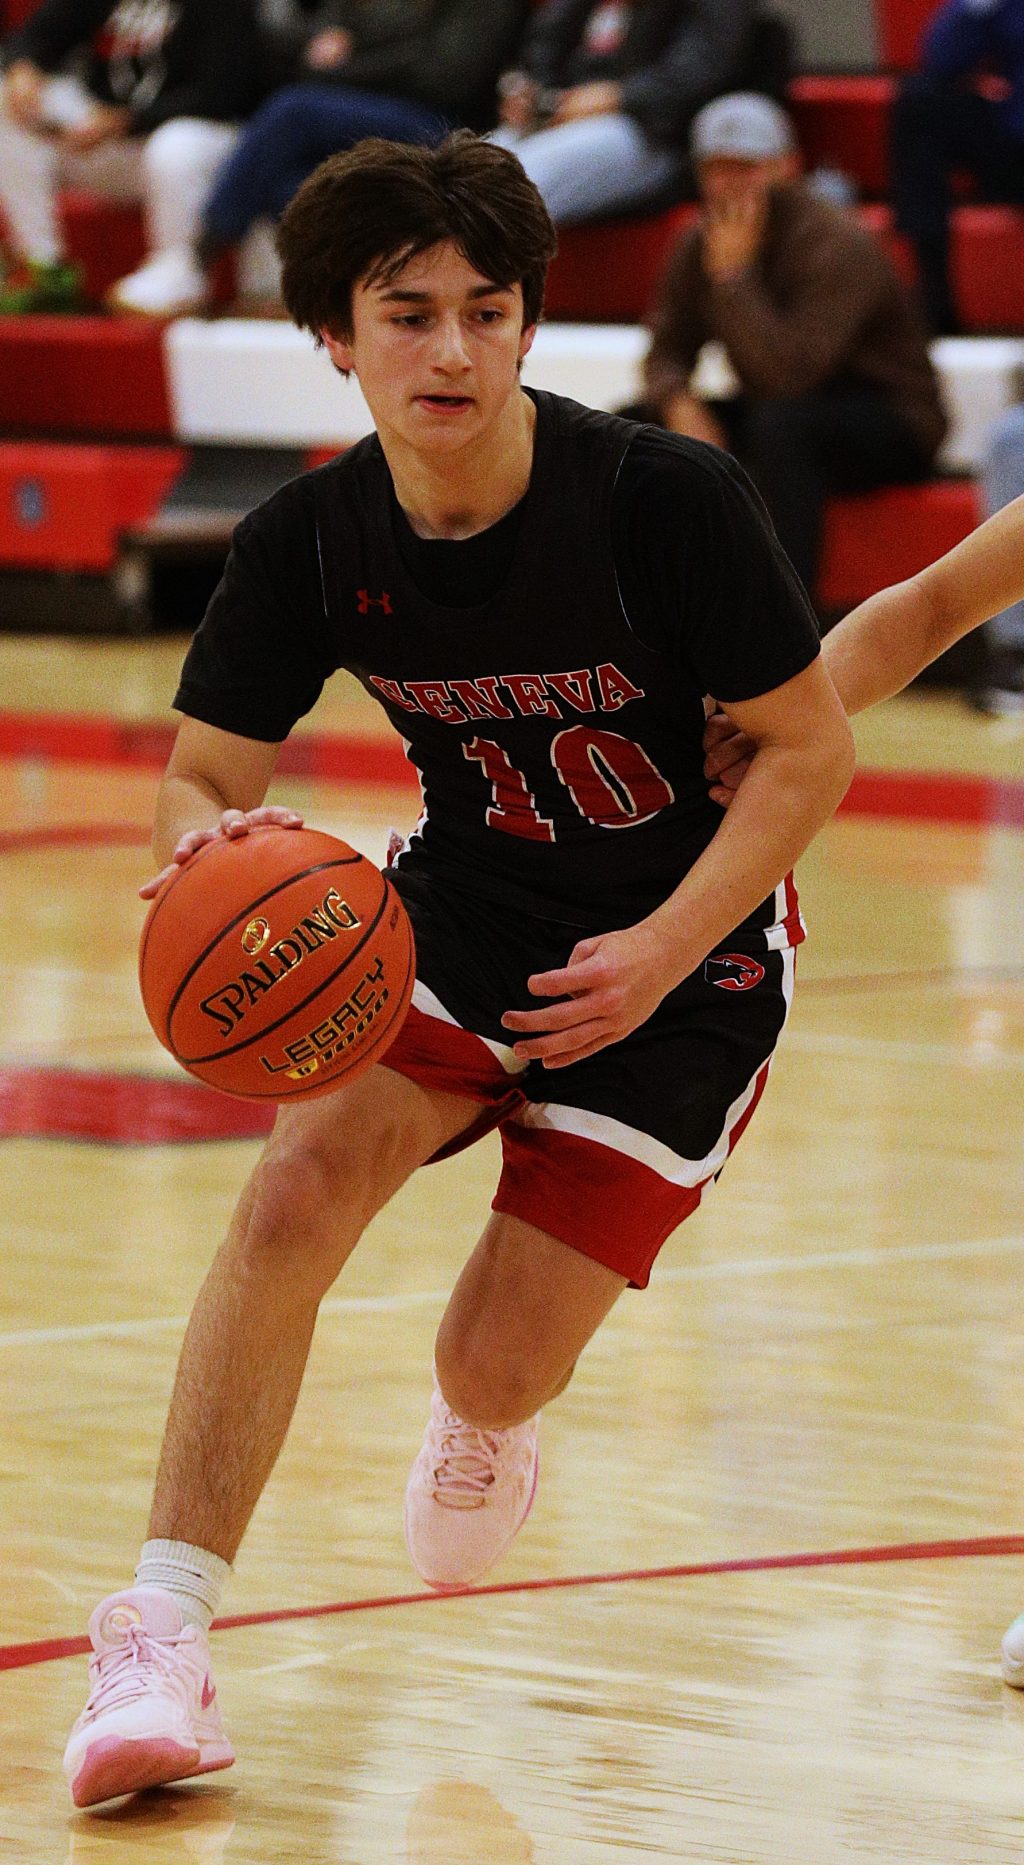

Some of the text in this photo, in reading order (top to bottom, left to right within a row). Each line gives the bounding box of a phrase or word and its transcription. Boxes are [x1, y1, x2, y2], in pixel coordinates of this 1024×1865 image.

[369, 662, 645, 724] GENEVA
[462, 724, 675, 843] 10
[200, 887, 362, 1038] SPALDING
[259, 955, 385, 1074] LEGACY
